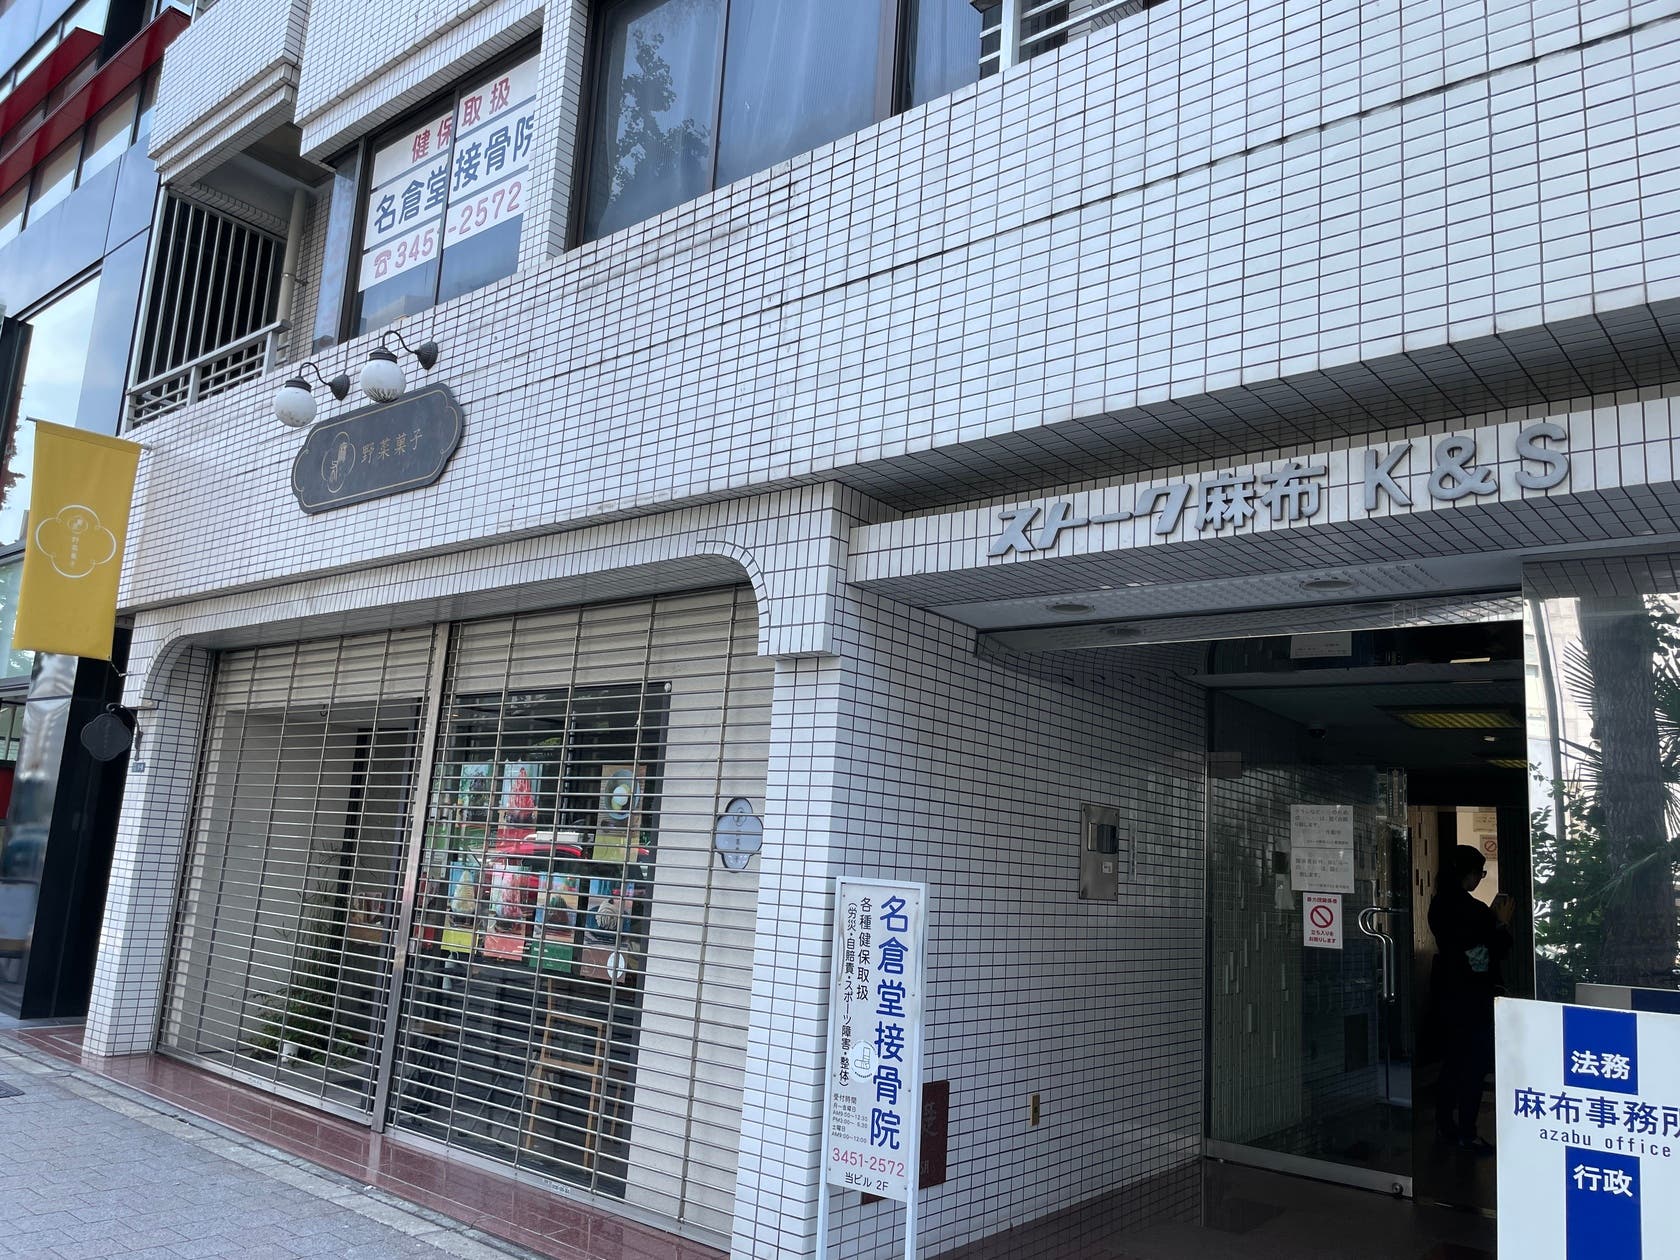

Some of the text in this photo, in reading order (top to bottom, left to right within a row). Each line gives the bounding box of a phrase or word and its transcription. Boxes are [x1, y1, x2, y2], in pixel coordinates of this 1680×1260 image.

[394, 181, 523, 268] 345-2572
[360, 428, 424, 465] 野菜菓子
[988, 462, 1327, 558] ストーク麻布
[855, 896, 873, 1002] 各種健保取扱
[869, 894, 909, 1151] 名倉堂接骨院
[1570, 1049, 1631, 1080] 法務
[1539, 1126, 1672, 1159] azabu office
[832, 1147, 905, 1178] 3451-2572
[1572, 1163, 1633, 1198] 行政
[844, 1171, 889, 1191] 当ビル 2F
